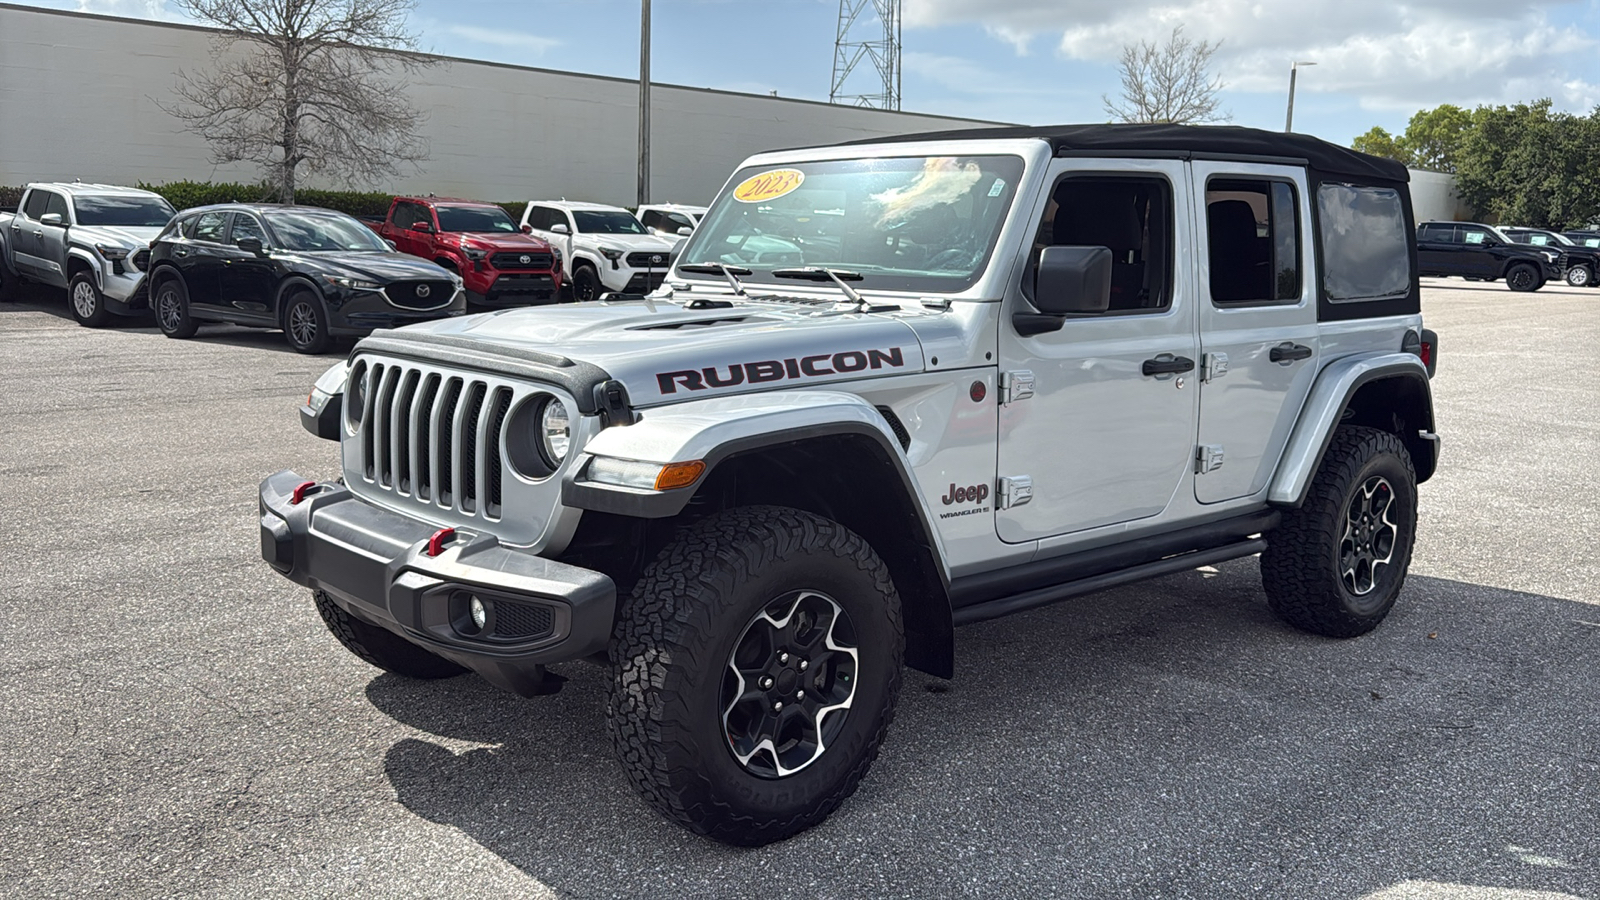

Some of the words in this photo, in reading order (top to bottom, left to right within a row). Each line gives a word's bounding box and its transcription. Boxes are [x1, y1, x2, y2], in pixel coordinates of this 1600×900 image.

[742, 173, 795, 198] 2023
[656, 347, 904, 395] RUBICON
[942, 483, 988, 505] Jeep
[939, 507, 982, 519] WRANGLER
